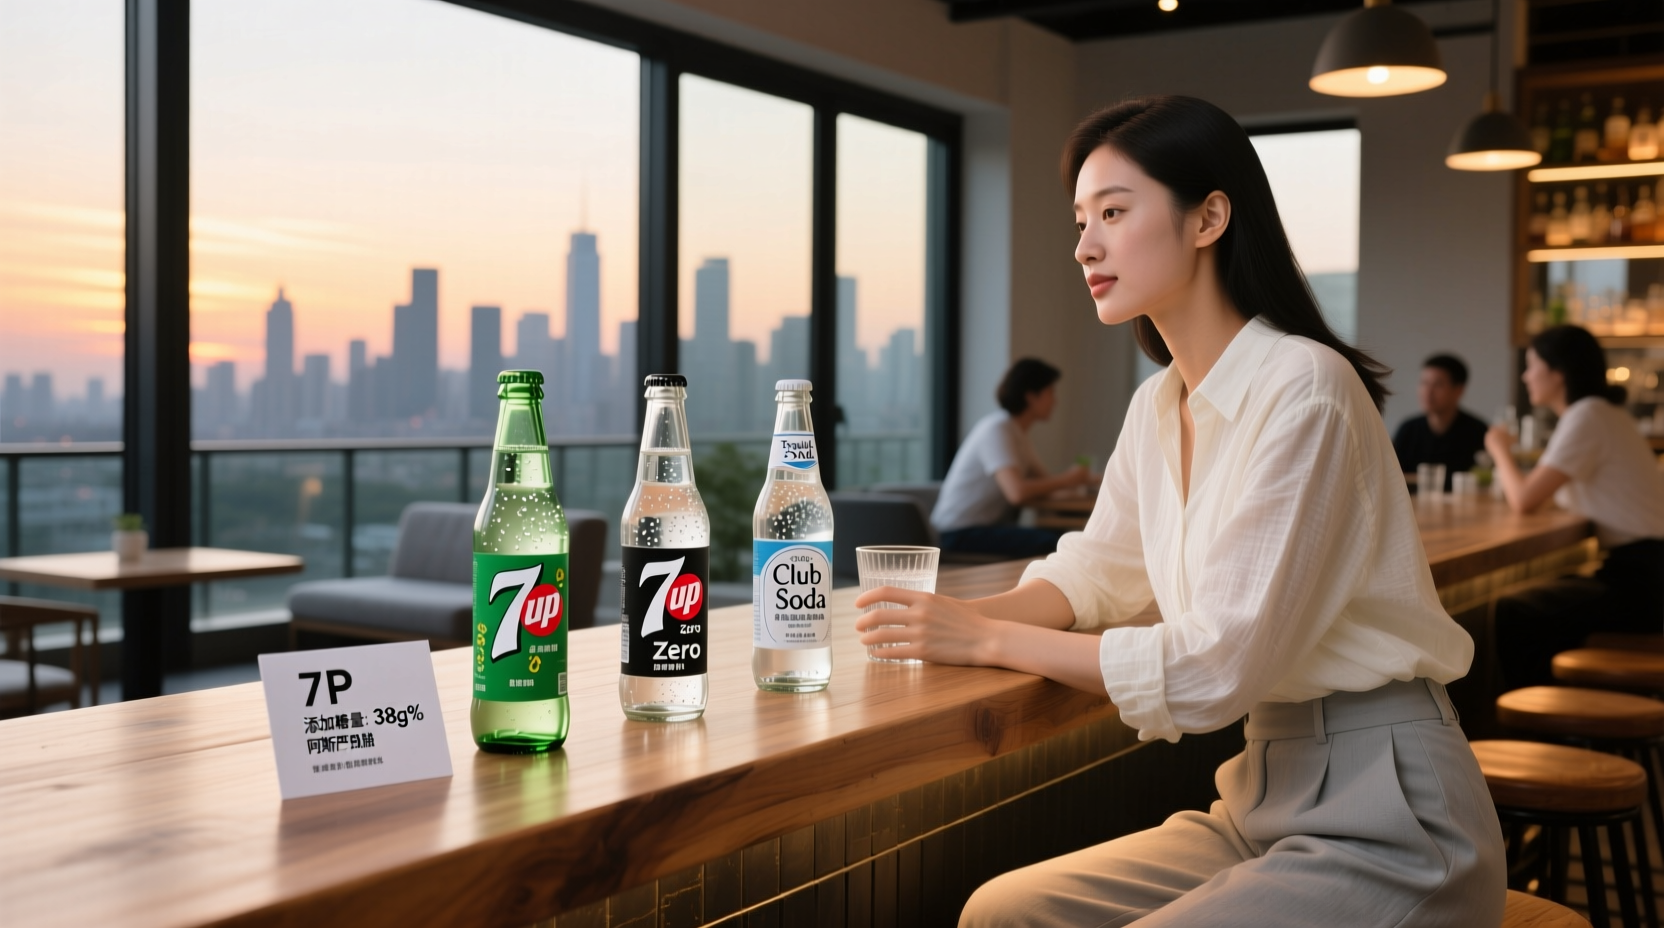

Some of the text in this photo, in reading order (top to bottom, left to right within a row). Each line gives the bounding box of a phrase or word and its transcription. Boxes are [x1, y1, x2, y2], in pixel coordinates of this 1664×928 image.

[772, 562, 822, 586] Club
[775, 587, 826, 610] Soda
[652, 641, 701, 660] Zero
[298, 669, 353, 707] 7P
[373, 703, 424, 728] 38g%
